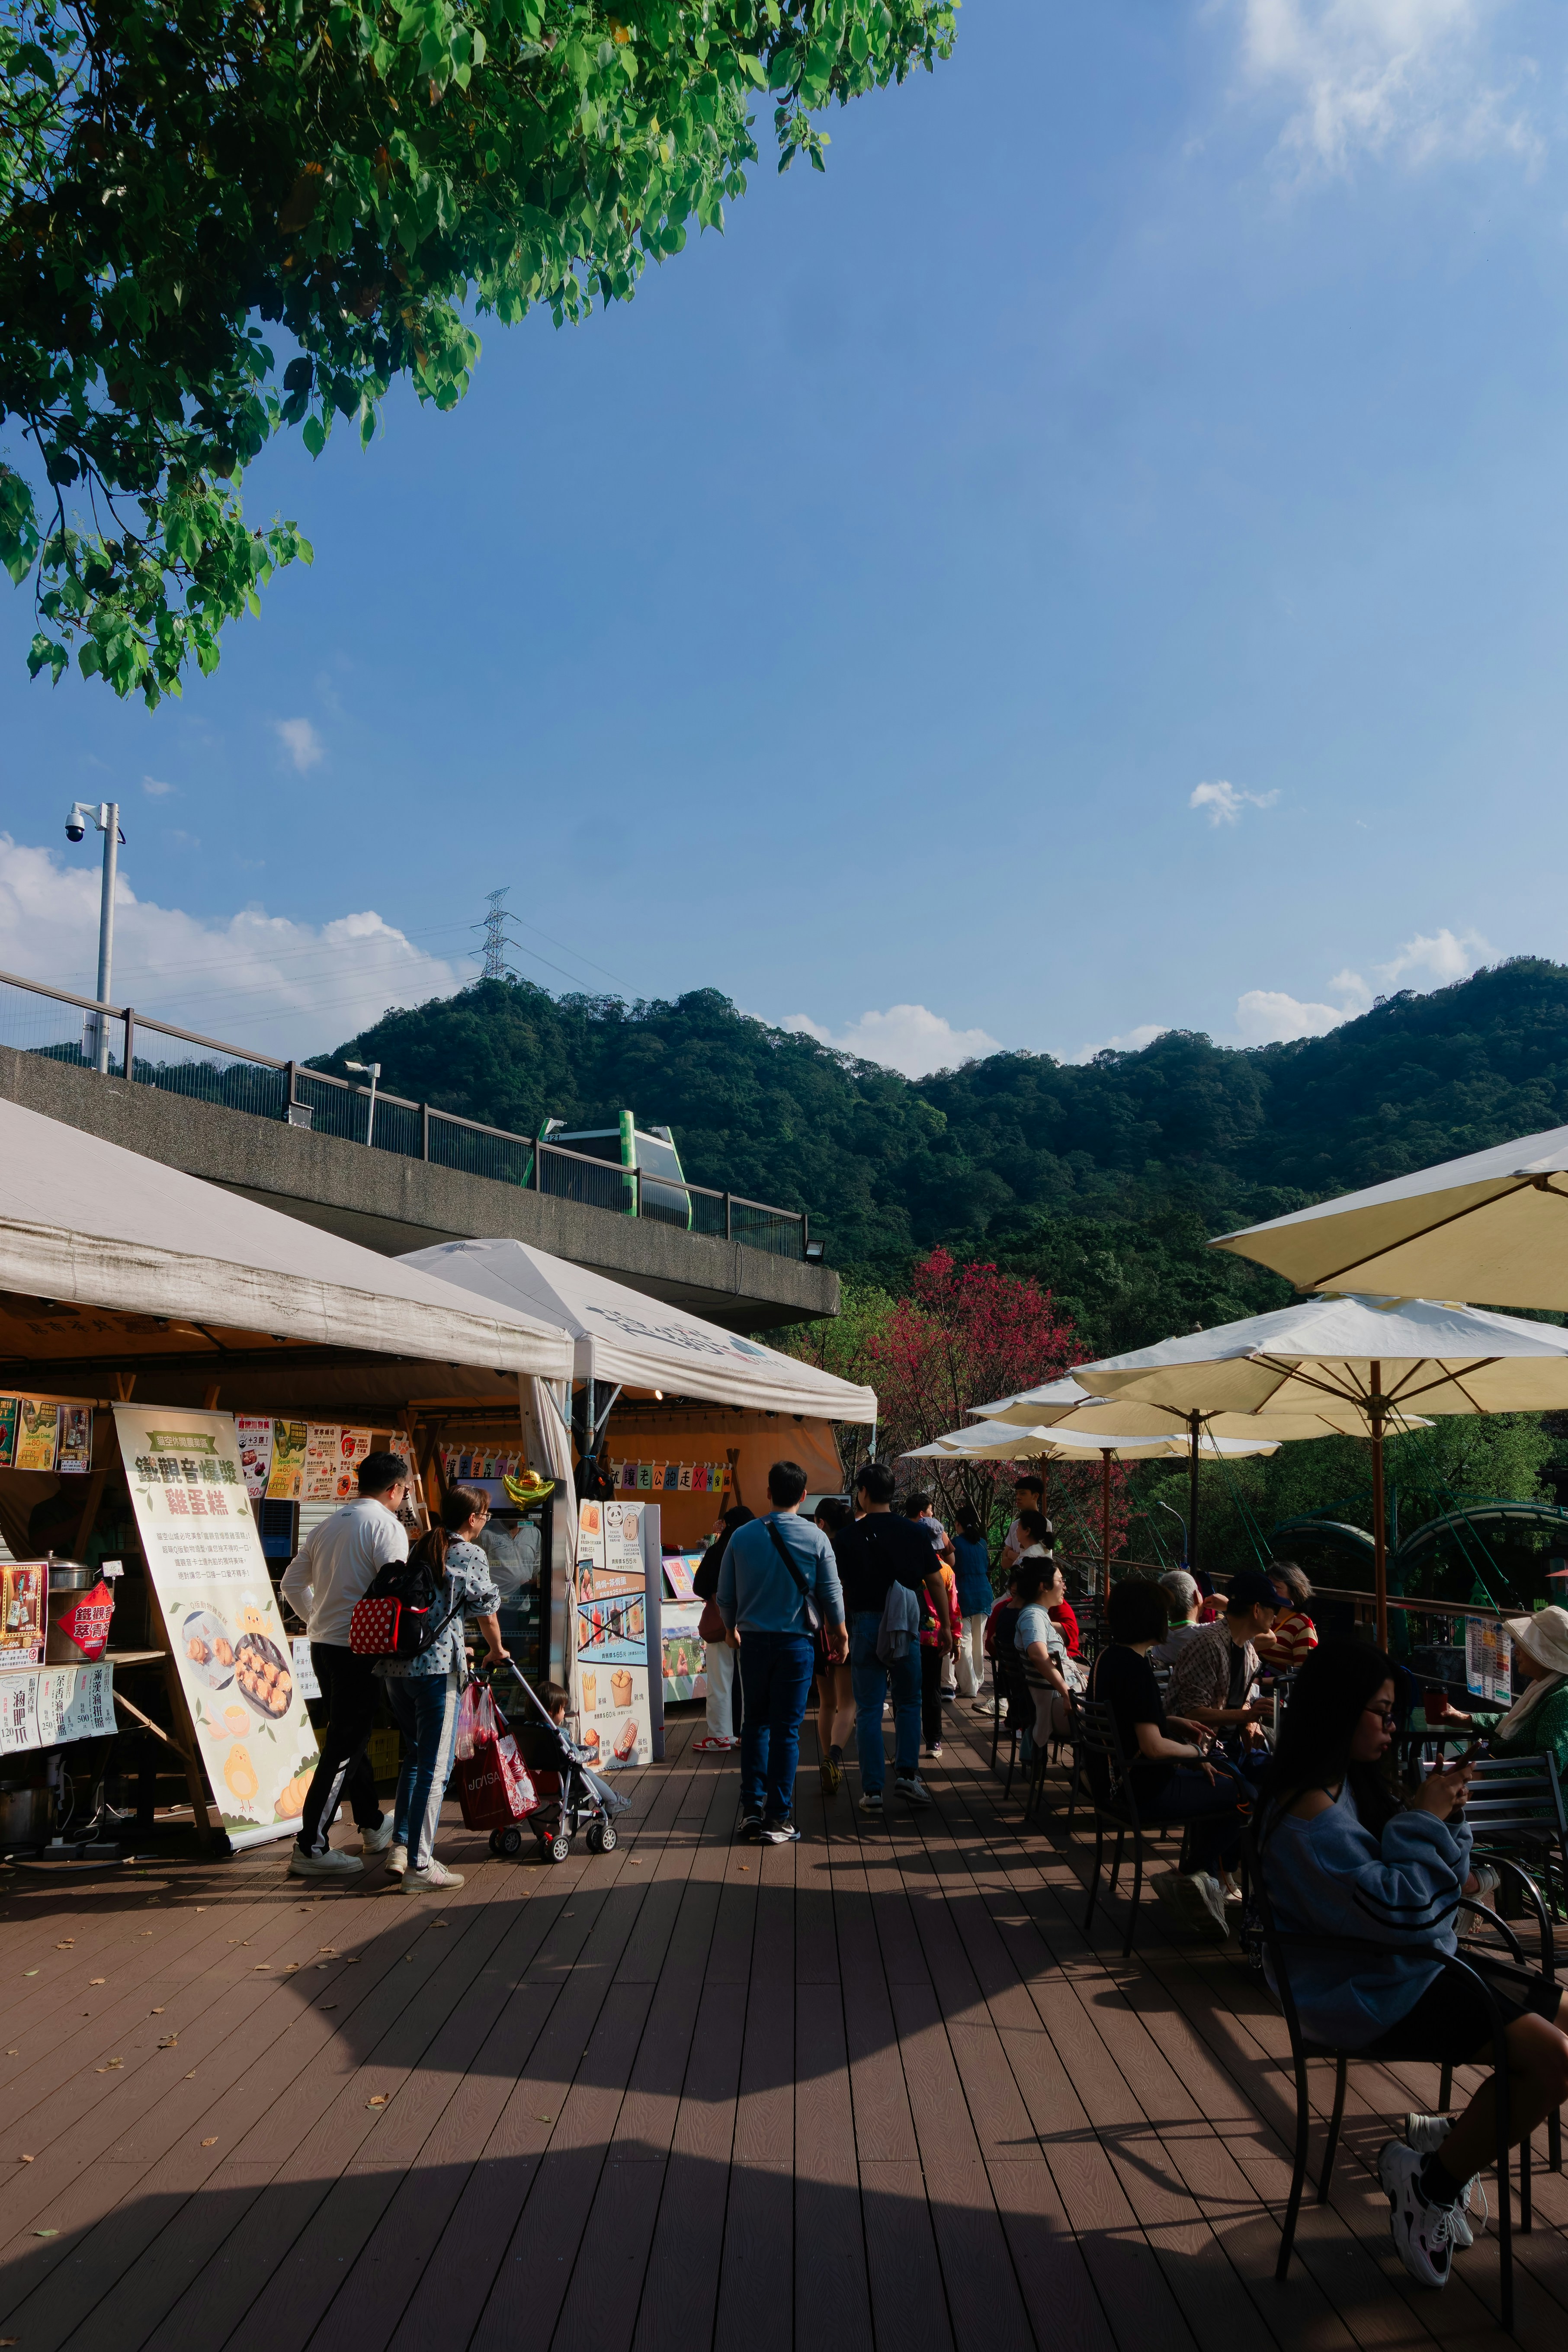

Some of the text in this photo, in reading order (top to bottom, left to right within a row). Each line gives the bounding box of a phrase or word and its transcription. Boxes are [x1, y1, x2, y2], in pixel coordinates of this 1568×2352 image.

[156, 1436, 208, 1448] 貓空休閒農業區
[277, 1458, 290, 1467] Special
[135, 1456, 239, 1486] 鐵觀音爆漿
[165, 1488, 229, 1515] 雞蛋糕
[75, 1605, 112, 1622] 鐵觀音
[27, 1678, 35, 1714] 暗黑香辣
[92, 1669, 105, 1729] 滿漢滷拼盤
[77, 1714, 89, 1723] 500
[42, 1721, 53, 1730] 250
[2, 1727, 14, 1738] 120
[602, 1749, 611, 1757] 雞排
[638, 1746, 648, 1755] 德腸
